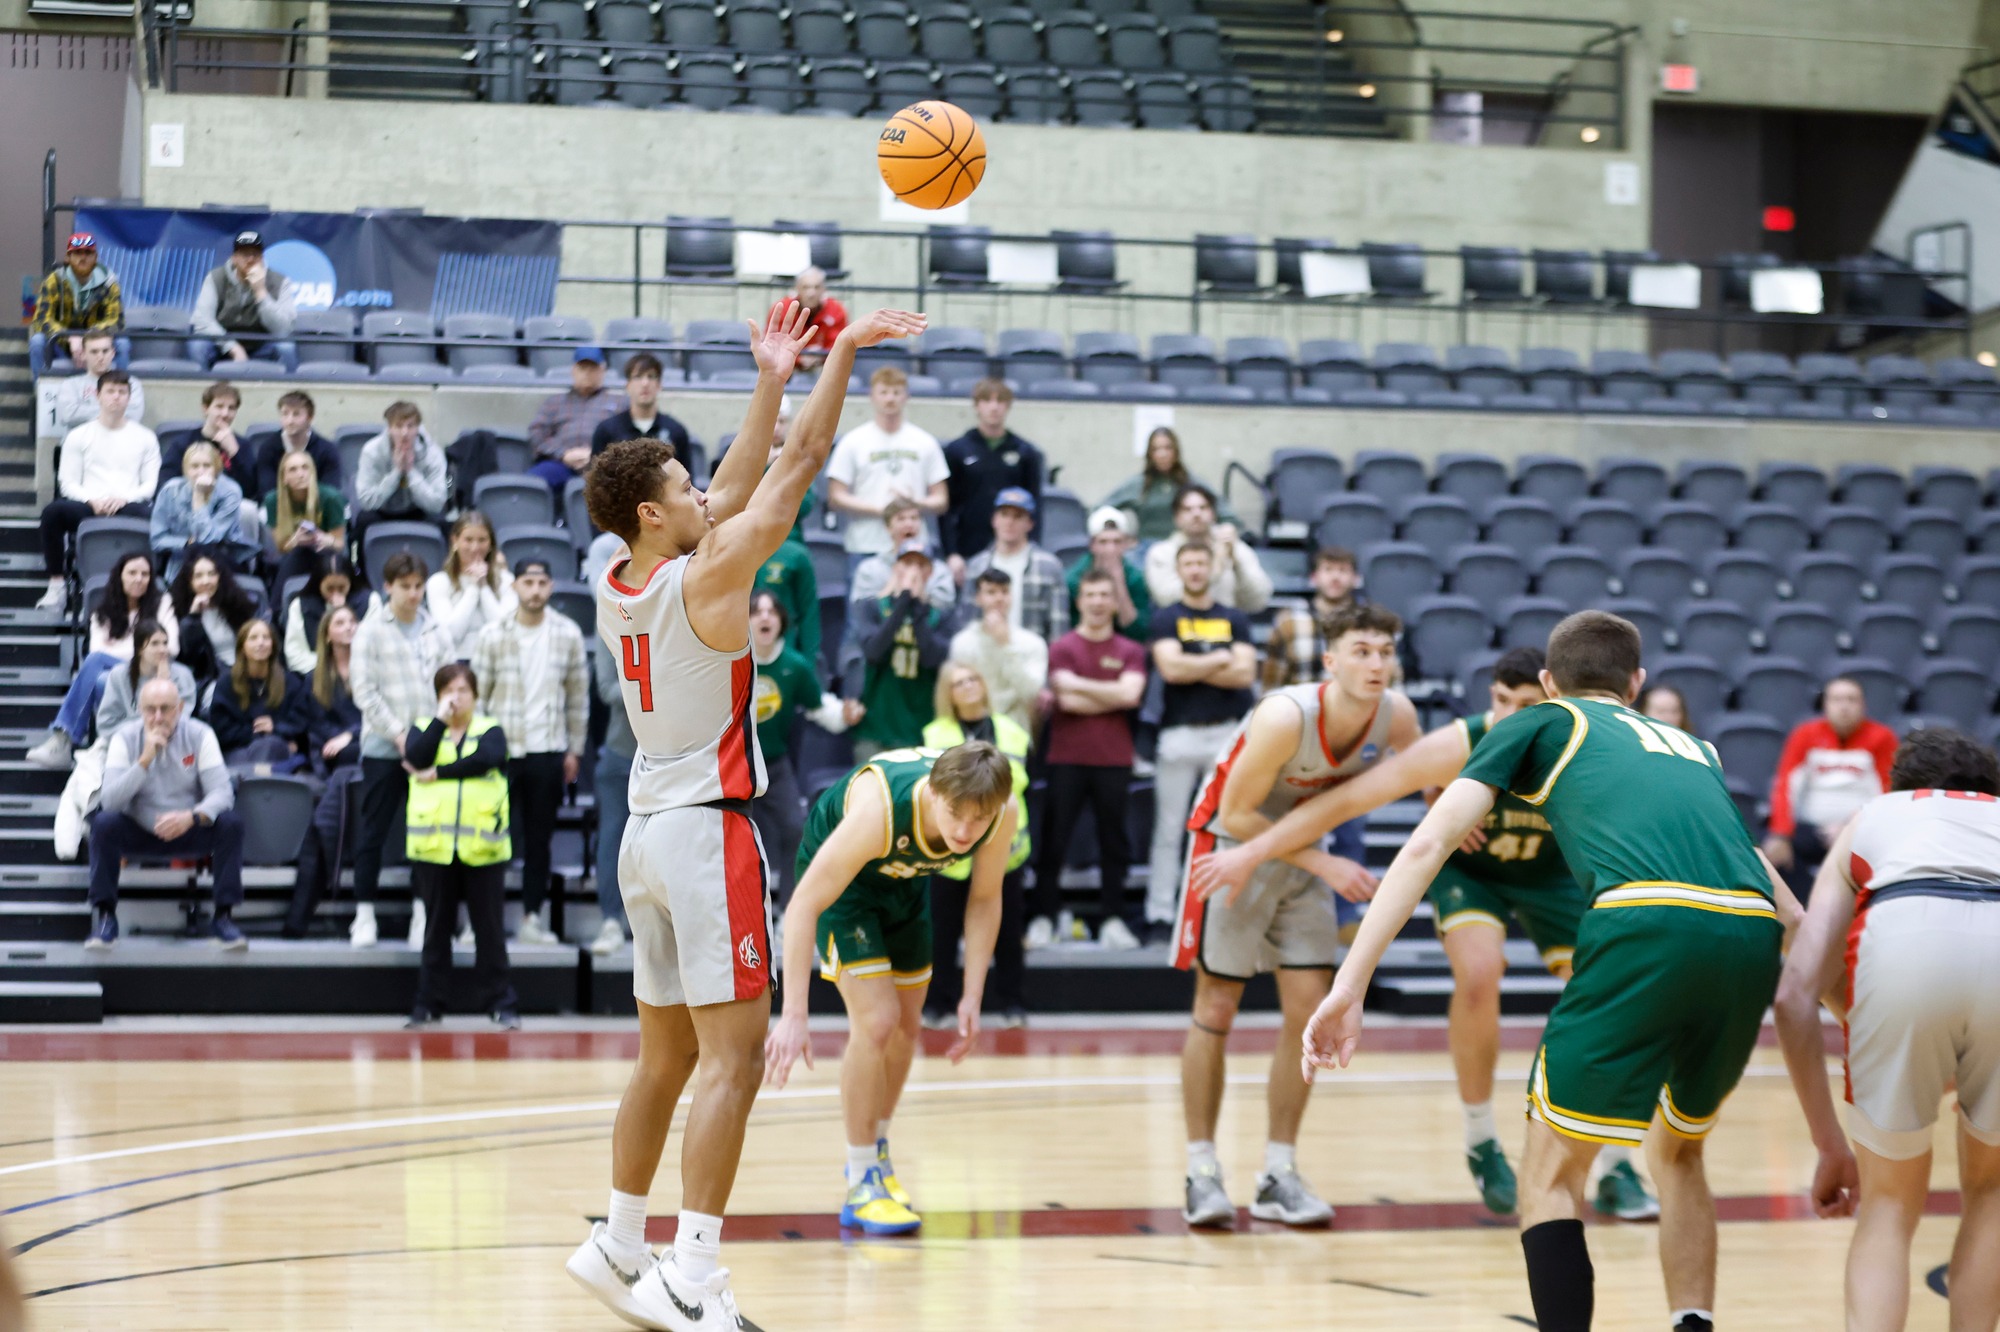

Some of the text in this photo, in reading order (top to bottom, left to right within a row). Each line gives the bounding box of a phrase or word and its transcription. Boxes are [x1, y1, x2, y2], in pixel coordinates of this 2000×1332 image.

[880, 127, 906, 144] CAA
[620, 633, 654, 712] 4
[1612, 711, 1712, 768] 10
[1488, 832, 1543, 862] 41
